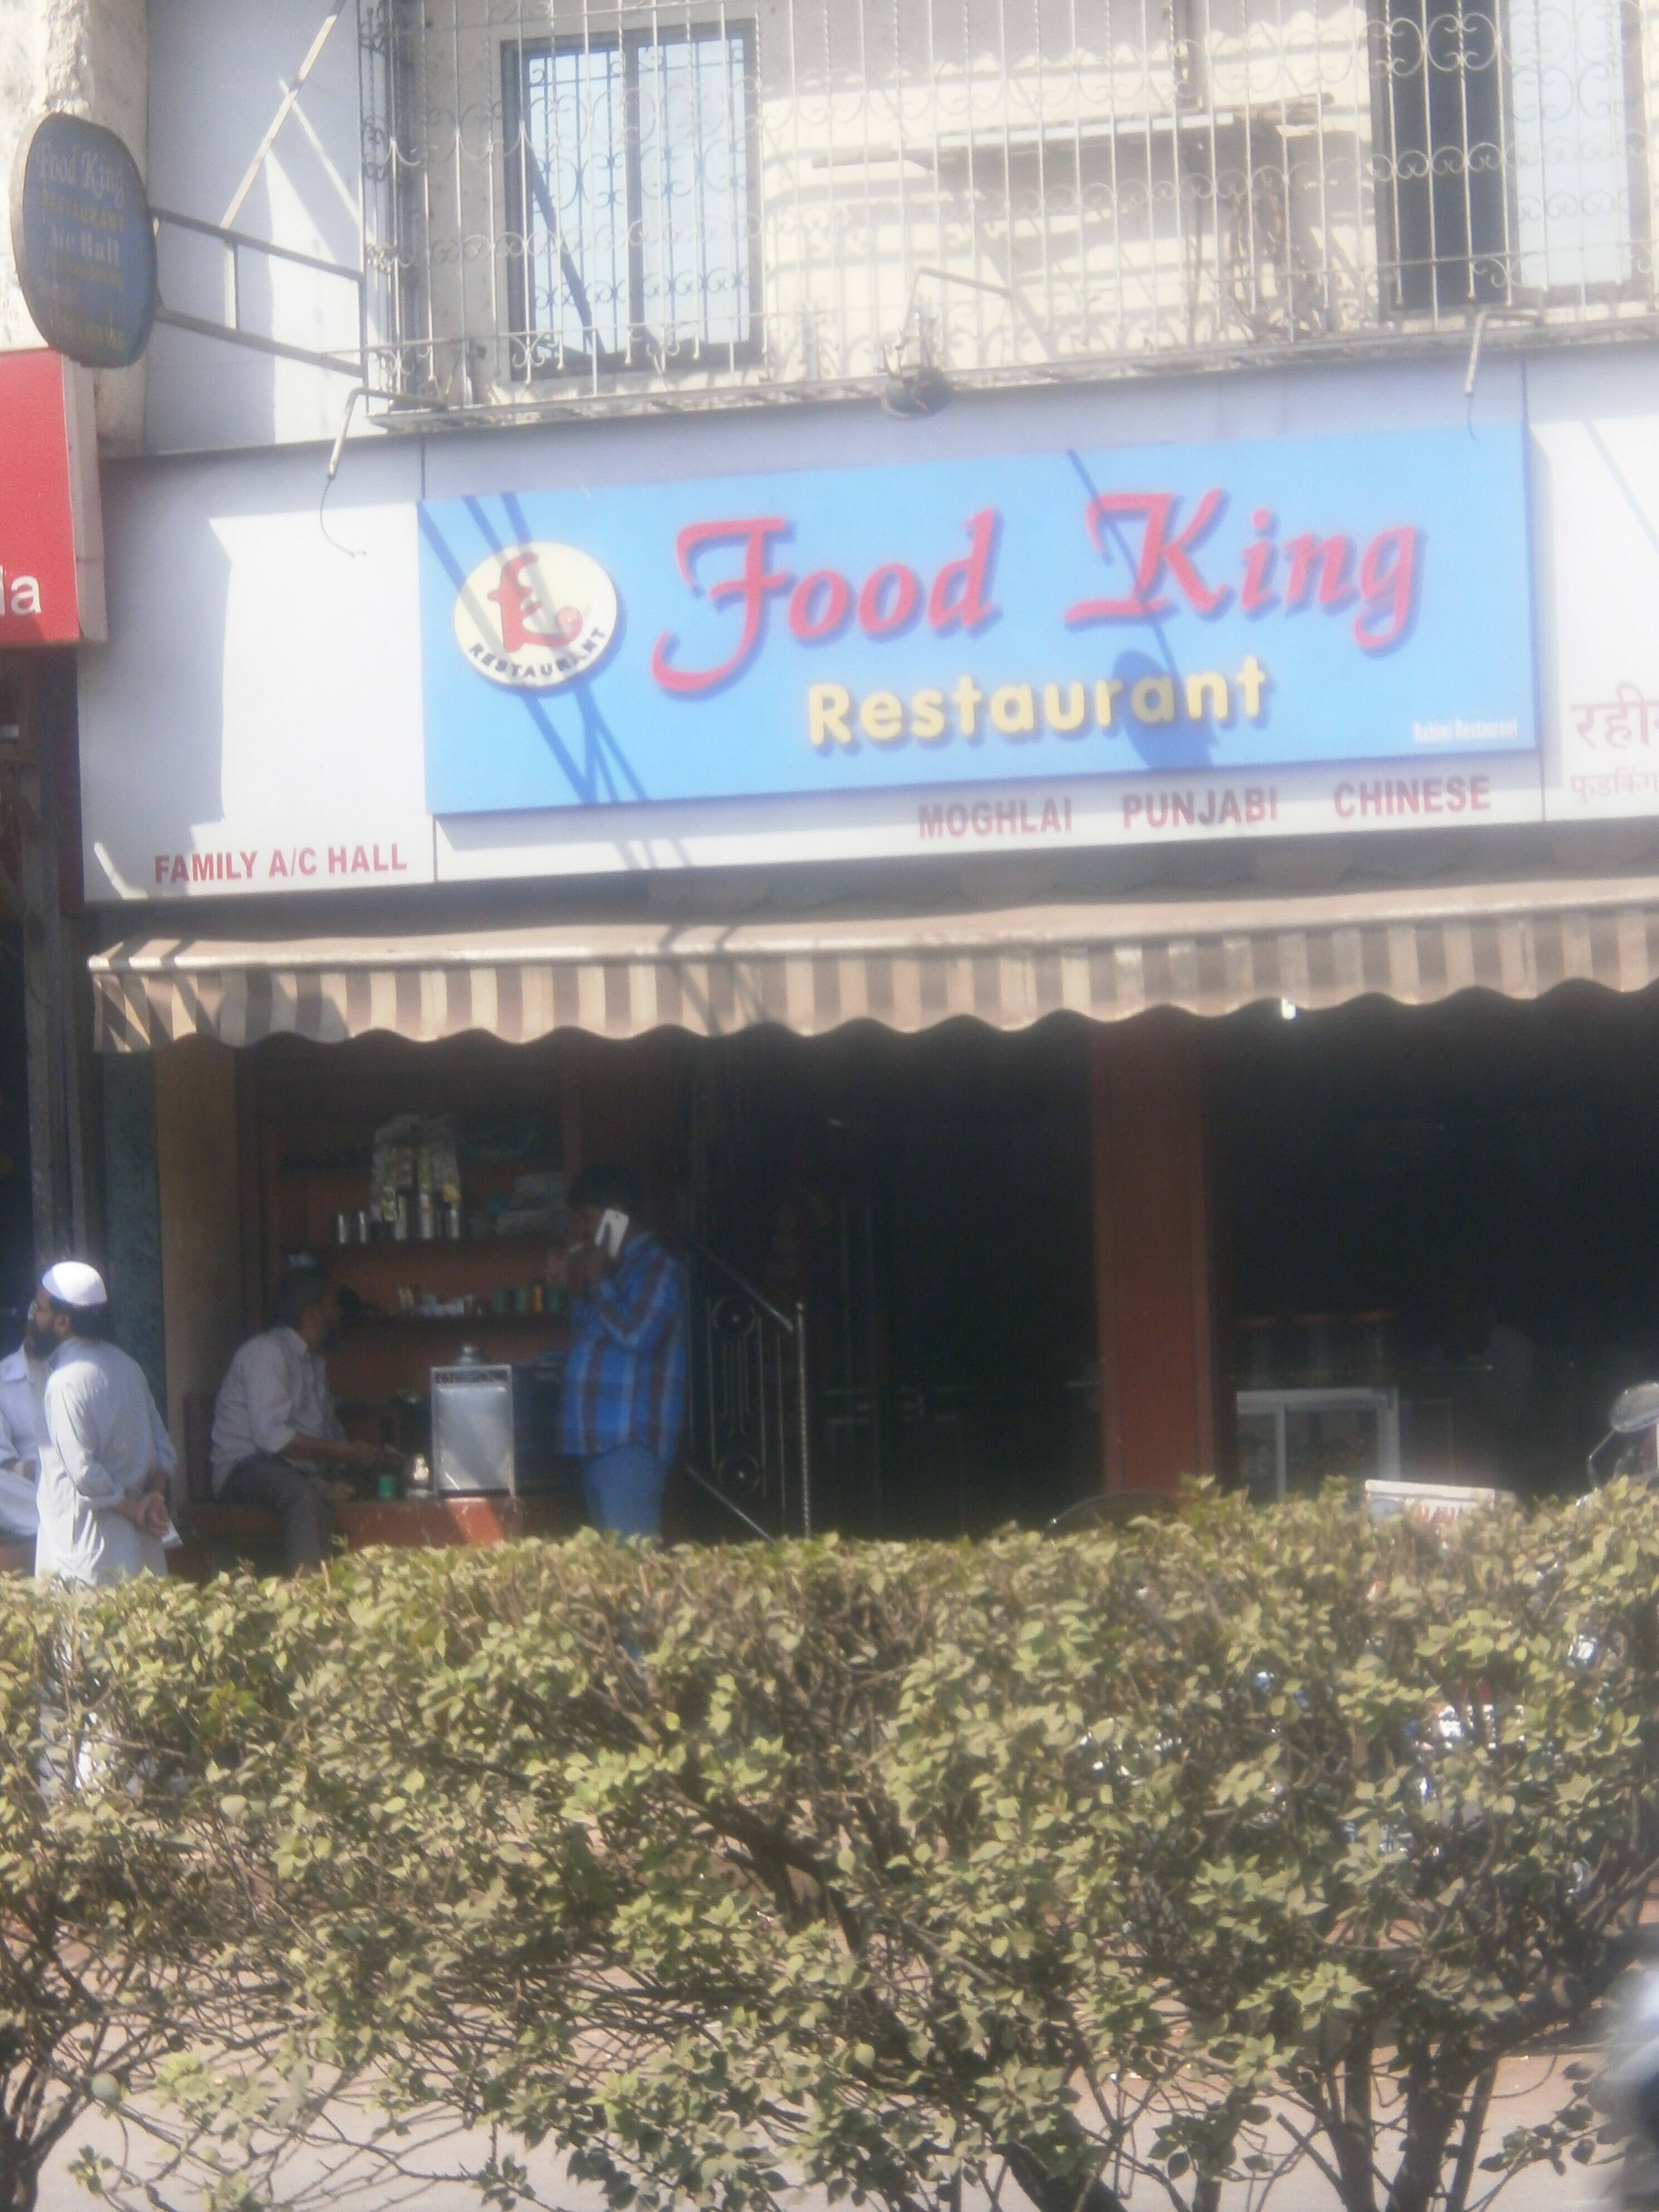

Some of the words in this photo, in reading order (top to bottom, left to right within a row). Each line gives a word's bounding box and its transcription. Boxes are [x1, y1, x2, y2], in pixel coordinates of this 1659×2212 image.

[651, 507, 997, 693] Food
[1063, 487, 1418, 651] King
[808, 655, 1266, 745] Restaurant
[1569, 680, 1659, 749] रही
[918, 796, 1072, 838] MOGHLAI
[1122, 785, 1279, 831] PUNJABI
[1333, 774, 1491, 819] CHINESE
[154, 850, 258, 884] FAMILY
[269, 847, 317, 877] A/C
[328, 842, 408, 874] HALL
